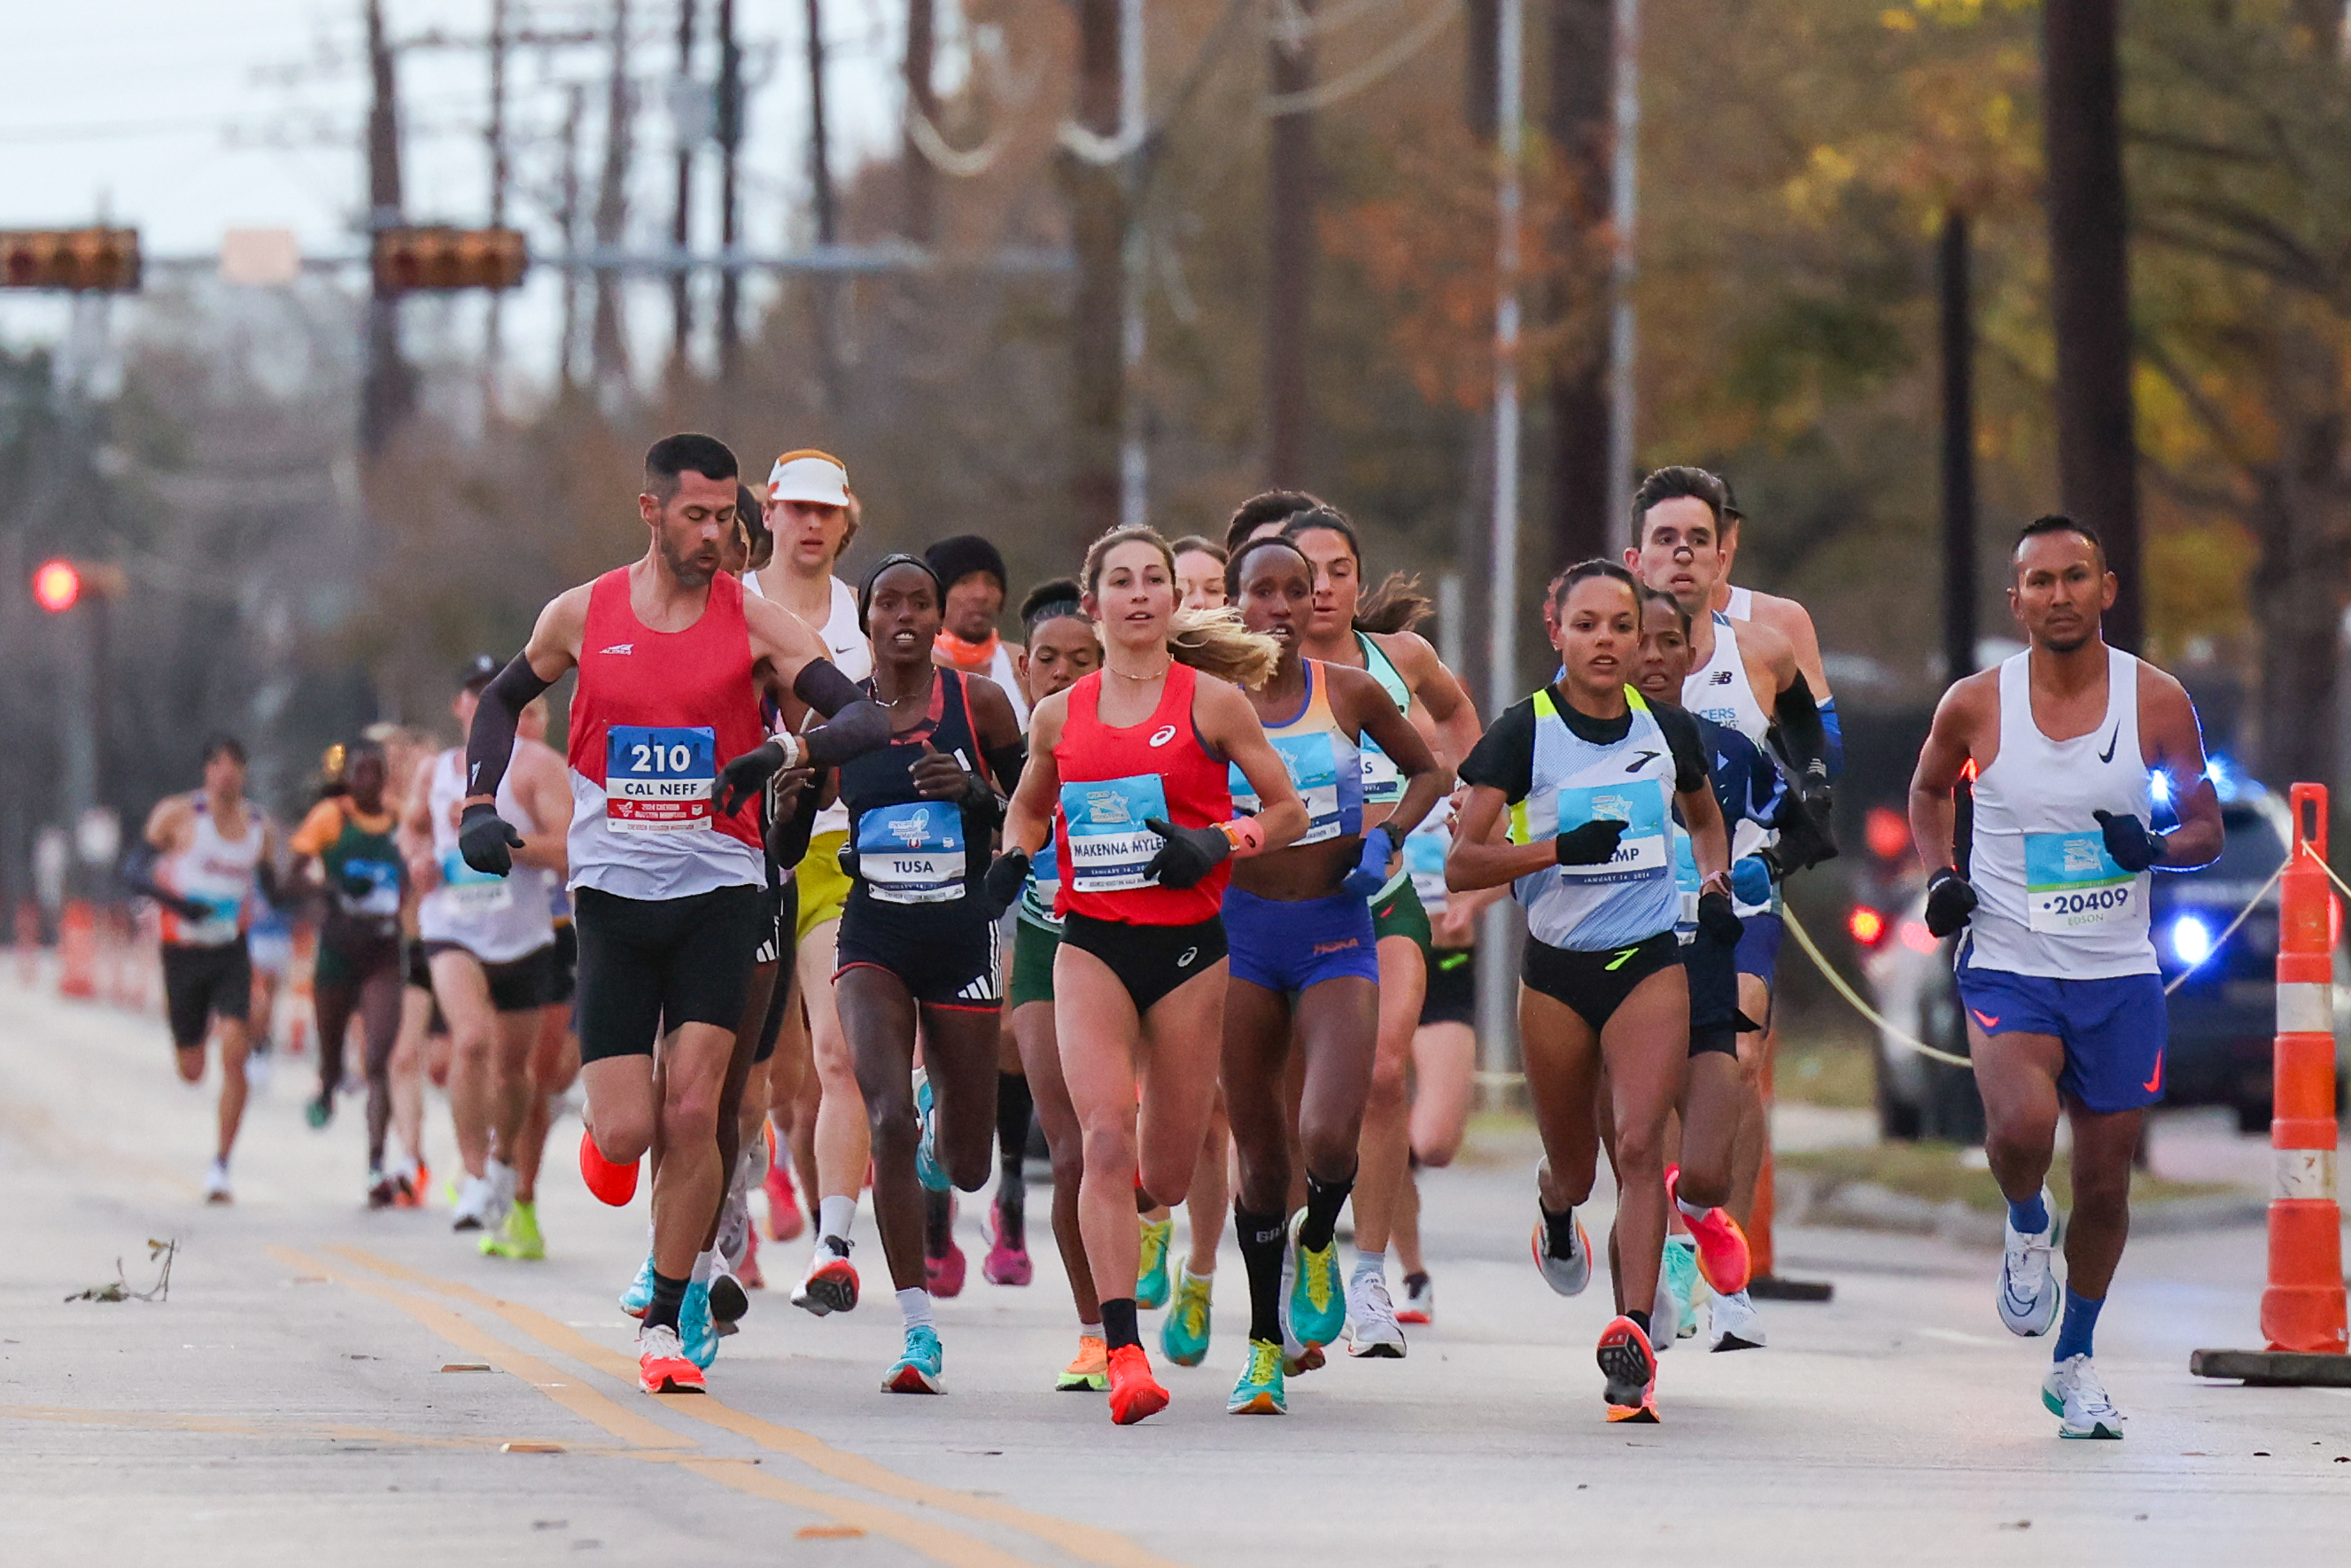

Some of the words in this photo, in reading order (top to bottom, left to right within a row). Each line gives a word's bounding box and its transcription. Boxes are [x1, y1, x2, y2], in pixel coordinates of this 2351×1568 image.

[630, 744, 691, 772] 210
[625, 783, 654, 796] CAL
[660, 783, 698, 796] NEFF
[1074, 842, 1129, 858] MAKENNA
[893, 860, 935, 873] TUSA
[2053, 888, 2129, 915] 20409
[2068, 914, 2104, 926] EDSON
